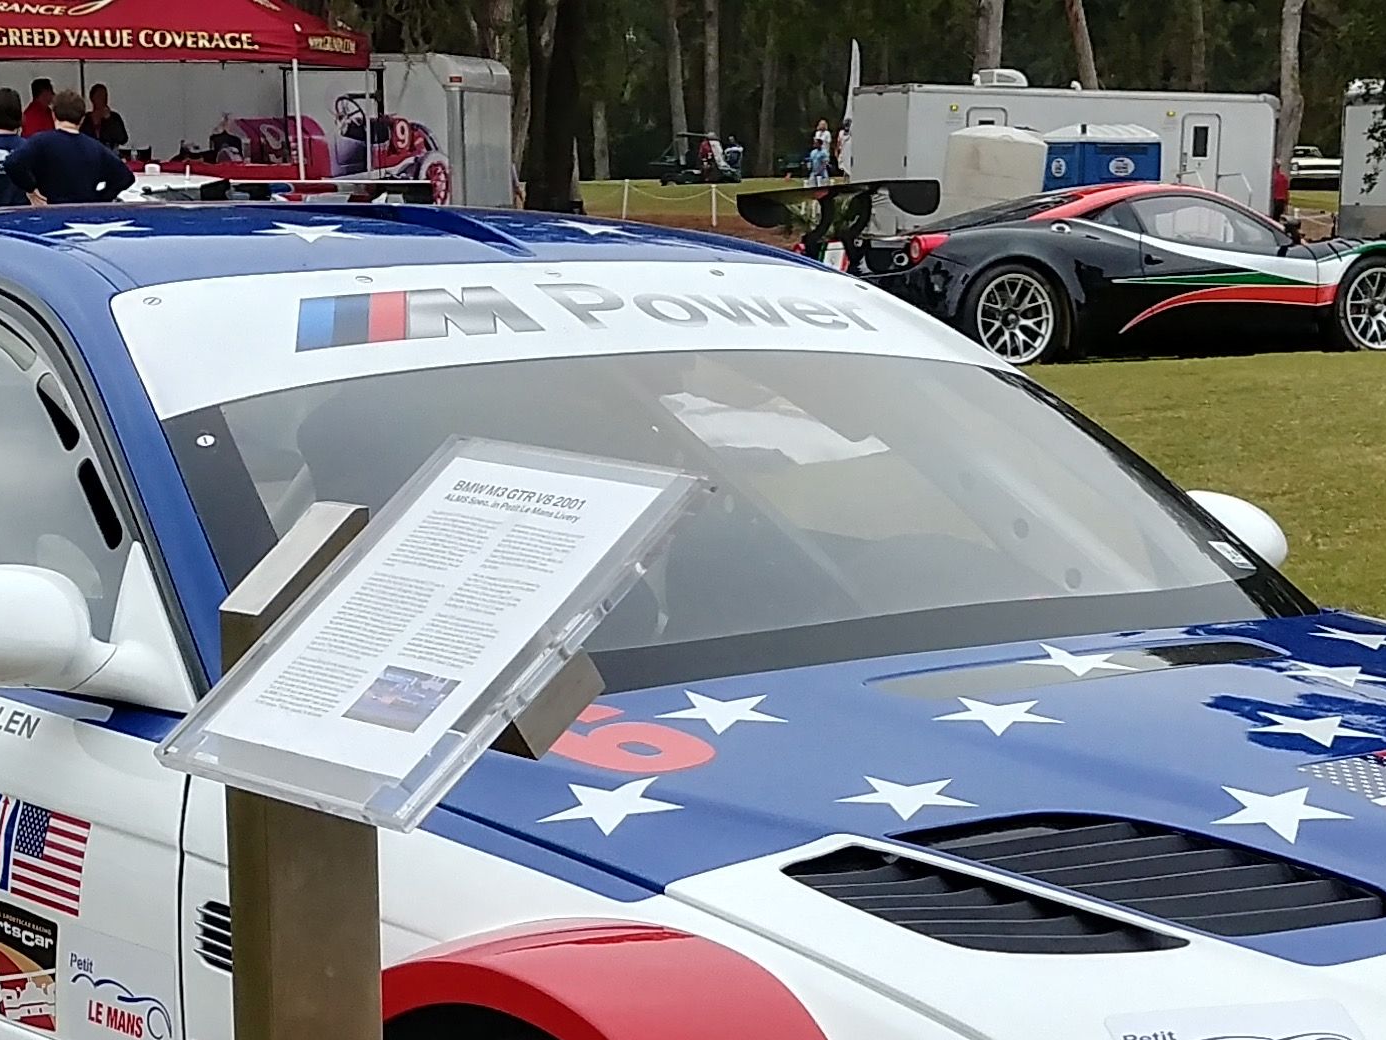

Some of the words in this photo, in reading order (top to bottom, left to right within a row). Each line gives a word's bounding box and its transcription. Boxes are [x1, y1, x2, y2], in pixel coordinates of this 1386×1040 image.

[64, 29, 133, 48] VALUE
[139, 30, 260, 50] COVERAGE.
[396, 121, 410, 149] 9
[534, 283, 878, 332] Power
[453, 480, 489, 494] BMW
[486, 485, 507, 498] M3
[507, 489, 536, 502] GTR
[552, 496, 586, 511] 2001
[554, 510, 580, 524] Livery
[548, 703, 716, 772] 6
[70, 952, 94, 974] Petit
[88, 999, 103, 1022] LE
[106, 1006, 144, 1039] MANS
